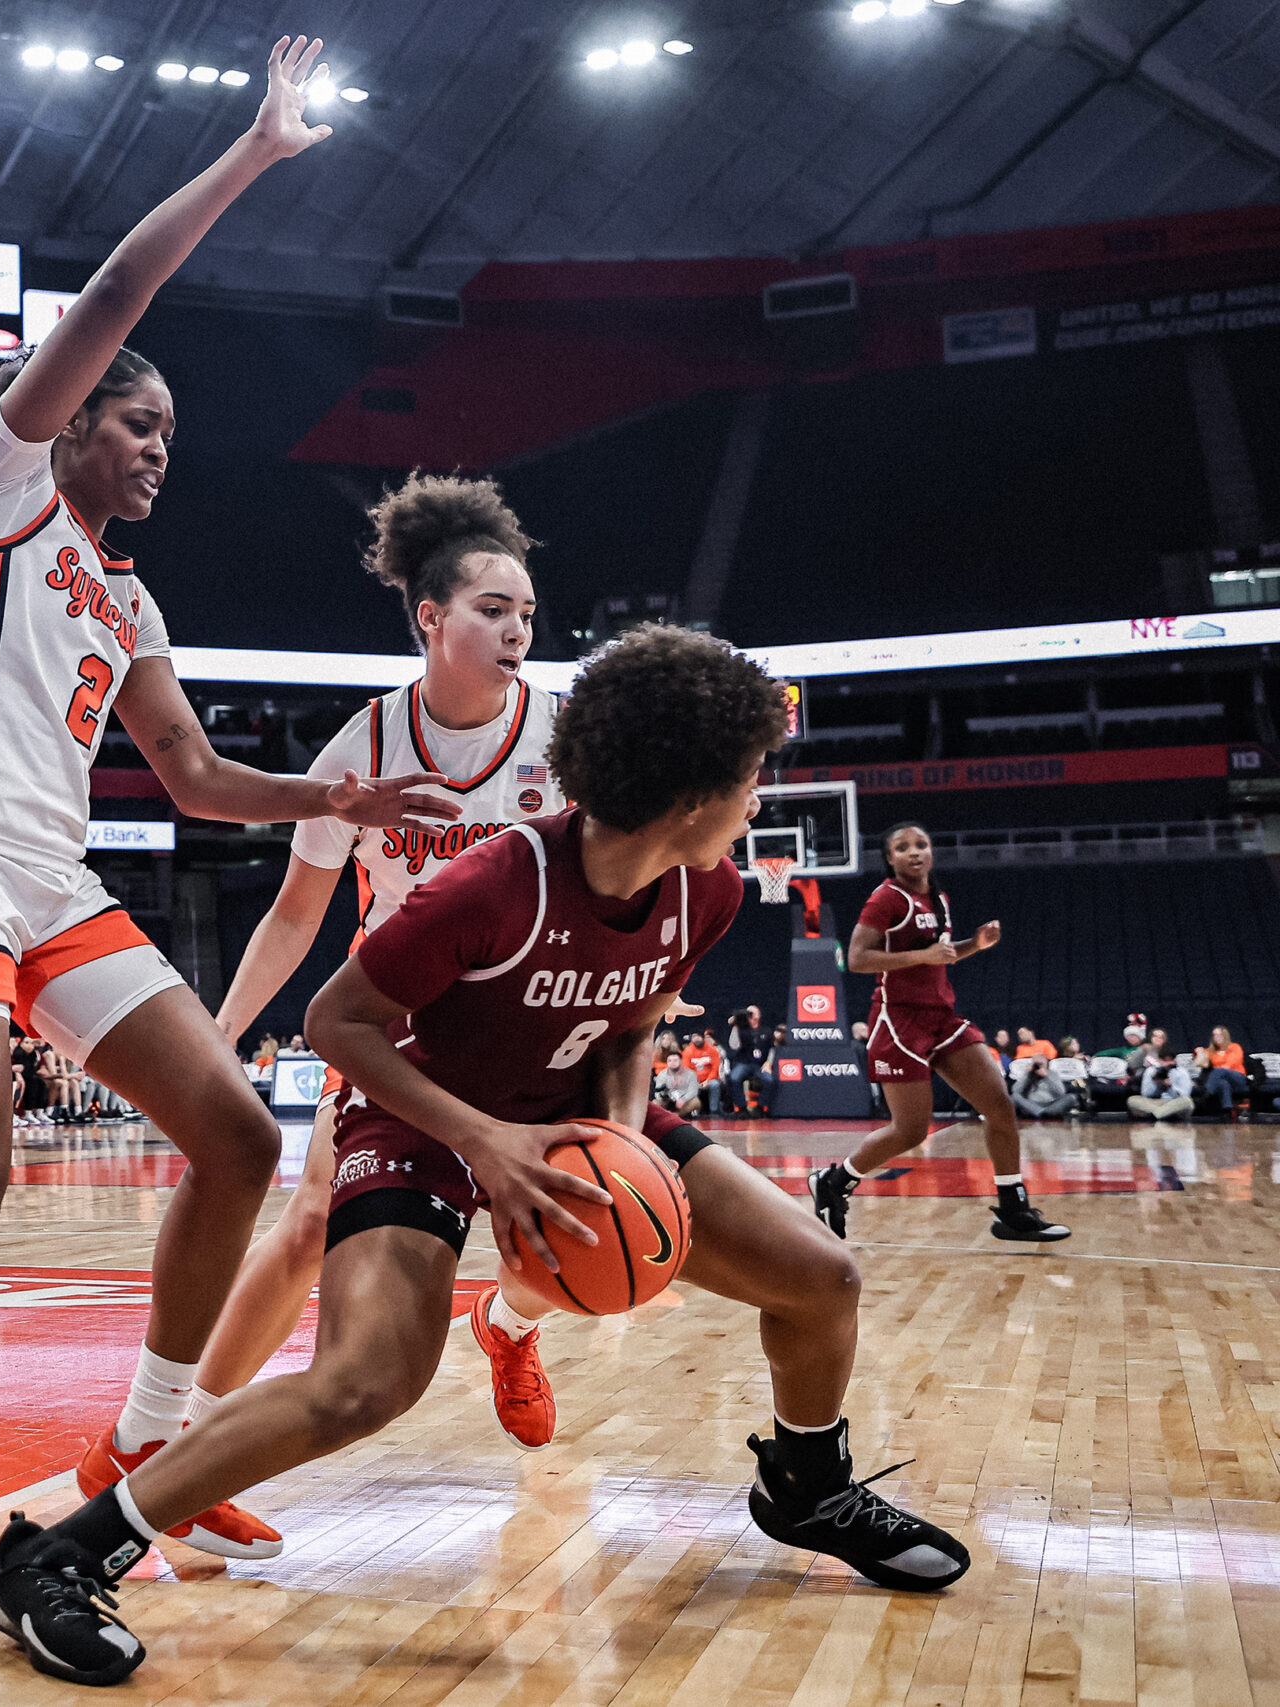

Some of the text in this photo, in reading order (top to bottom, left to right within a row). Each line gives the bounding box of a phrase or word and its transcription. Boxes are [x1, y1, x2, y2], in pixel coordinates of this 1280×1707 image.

[1131, 617, 1177, 639] NYE
[66, 653, 114, 750] 2
[967, 760, 1065, 784] HONOR
[103, 827, 148, 843] Bank
[523, 955, 670, 1008] COLGATE
[546, 1019, 609, 1069] 8
[791, 1028, 843, 1040] TOYOTA
[804, 1064, 860, 1076] TOYOTA
